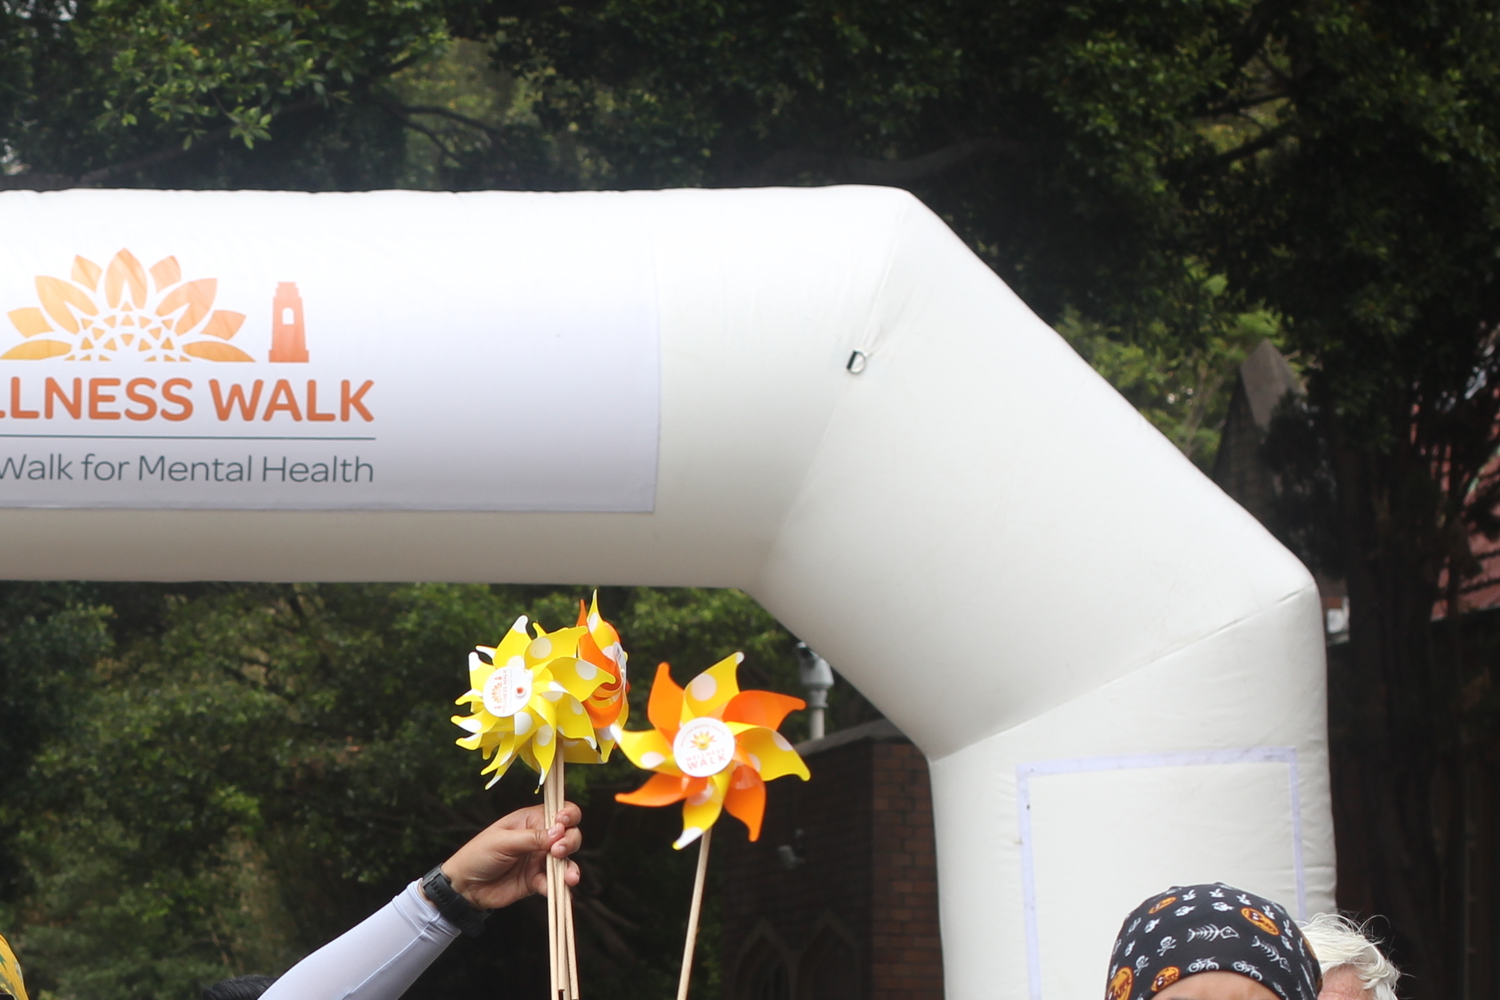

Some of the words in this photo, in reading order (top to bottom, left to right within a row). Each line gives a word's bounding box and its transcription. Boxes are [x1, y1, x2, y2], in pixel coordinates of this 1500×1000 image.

[208, 378, 375, 423] WALK
[80, 453, 130, 481] for
[138, 455, 253, 482] Mental
[262, 455, 375, 483] Health
[686, 755, 726, 770] WALK
